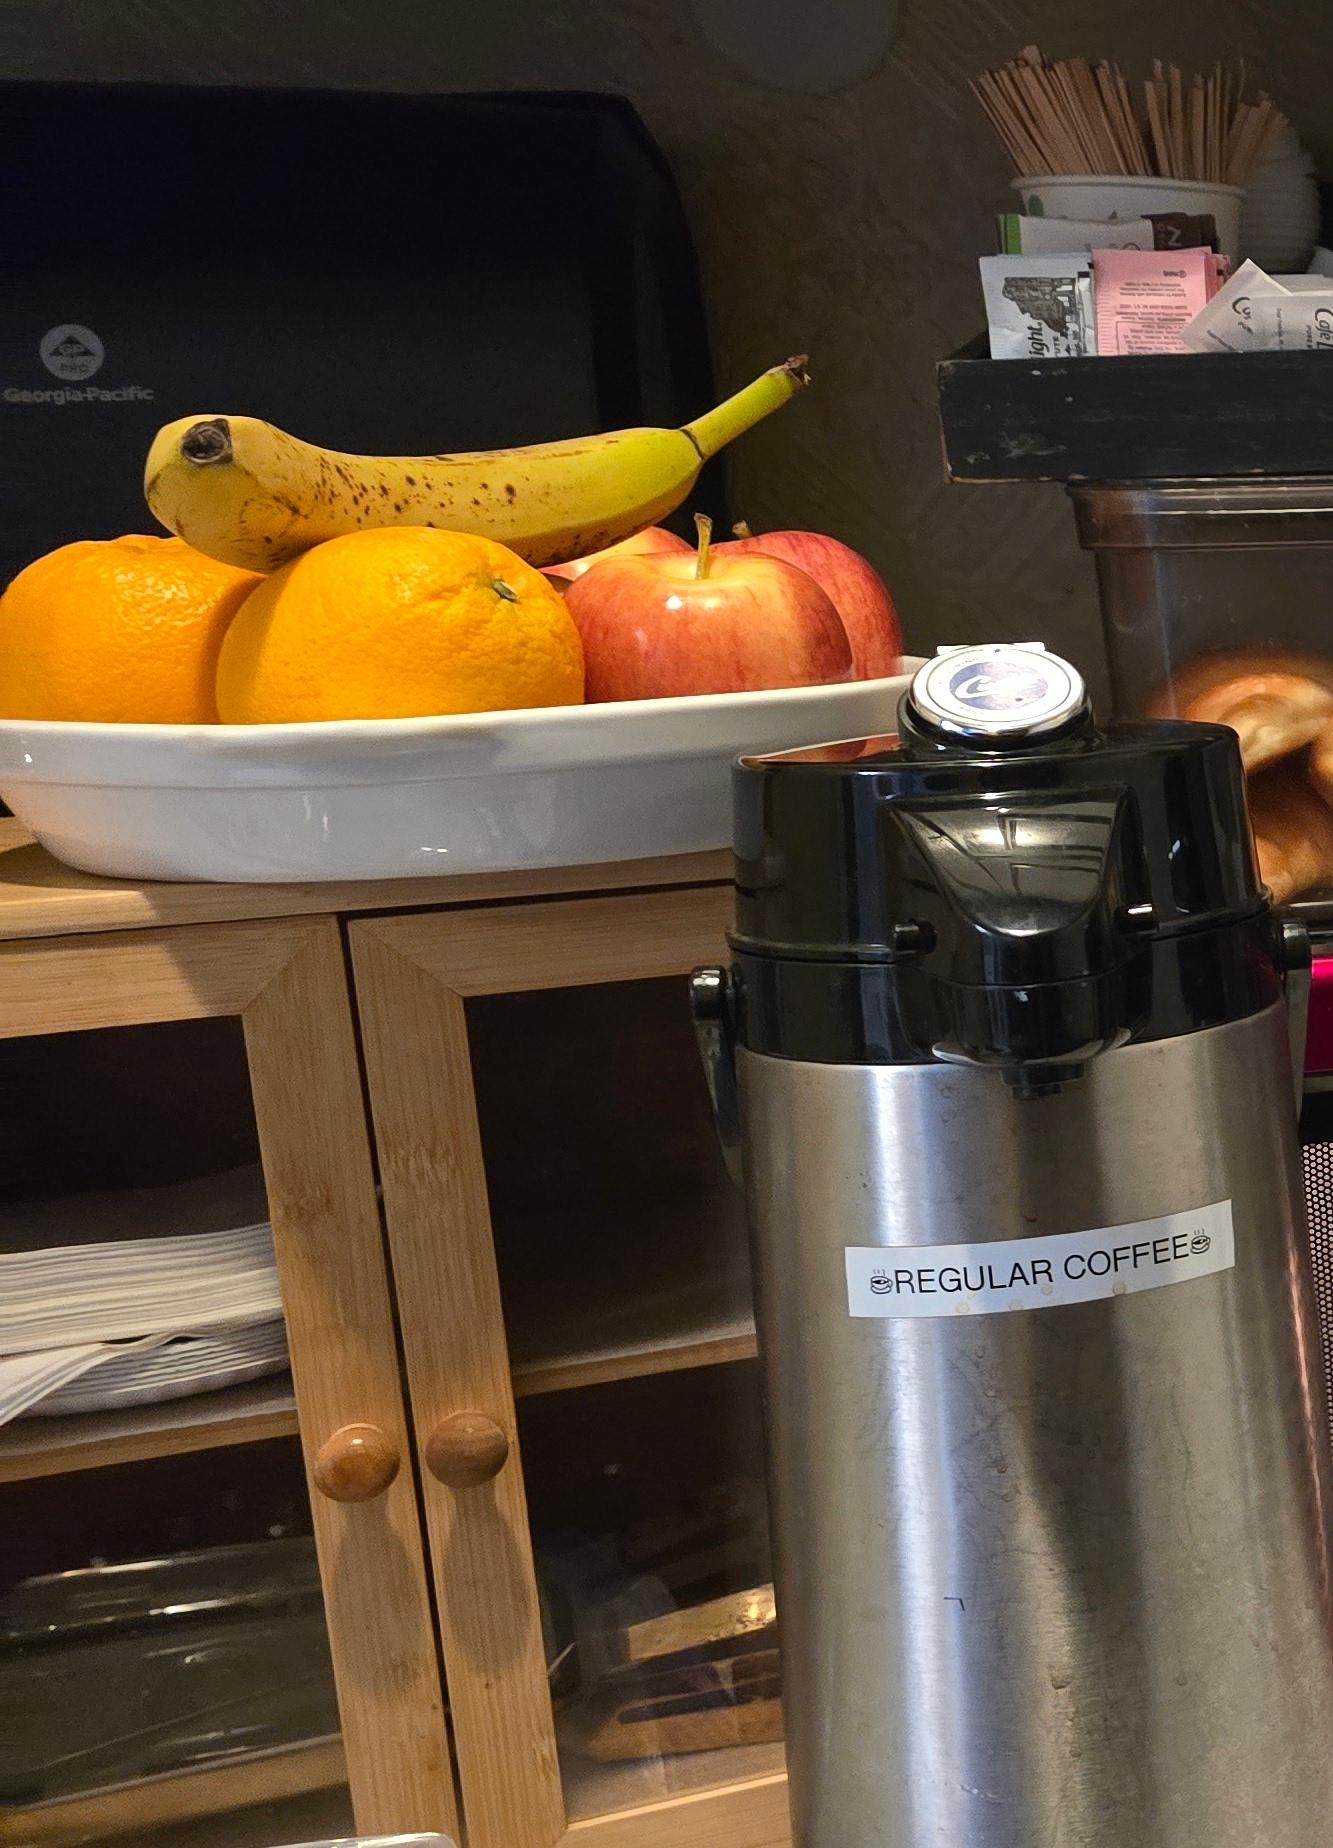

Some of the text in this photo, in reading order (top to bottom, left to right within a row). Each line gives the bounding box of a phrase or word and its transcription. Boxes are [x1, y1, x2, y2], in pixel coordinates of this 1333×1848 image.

[2, 386, 155, 405] Georgia-Pacific
[895, 1233, 1190, 1293] REGULAR COFFEE
